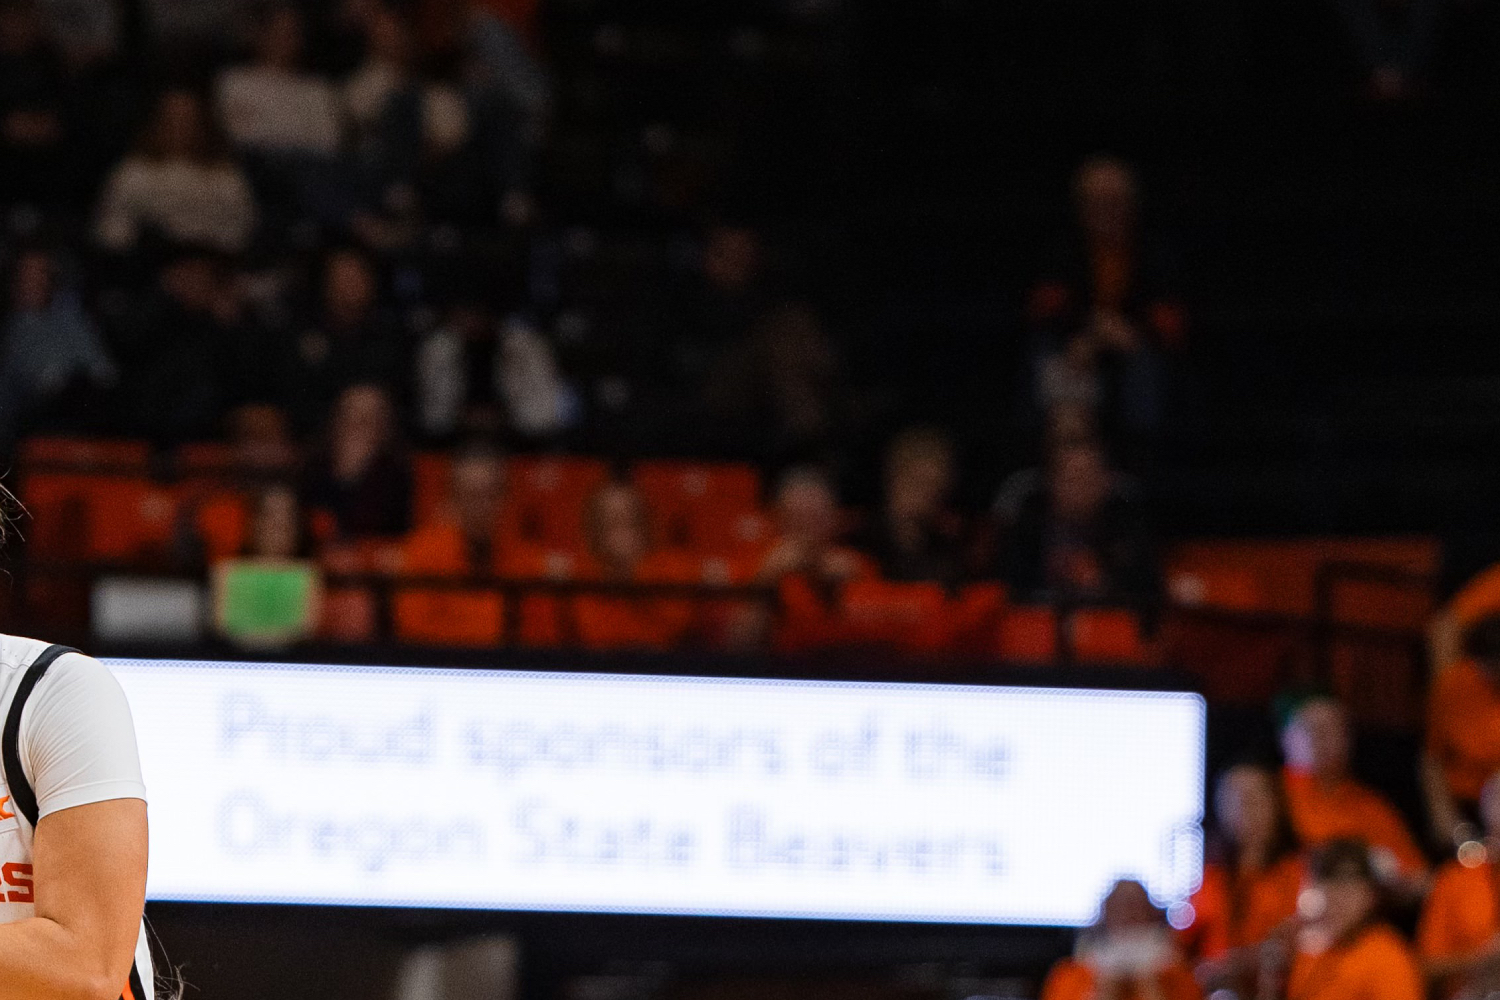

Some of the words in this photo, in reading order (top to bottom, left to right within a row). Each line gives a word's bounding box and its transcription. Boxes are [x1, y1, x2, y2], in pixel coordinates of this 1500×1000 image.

[216, 690, 438, 766] Proud
[462, 716, 785, 781] sponsors
[808, 709, 880, 780] of
[903, 710, 1017, 783] the
[216, 788, 487, 875] Oregon
[509, 797, 700, 871] State
[724, 801, 1008, 881] Beavers
